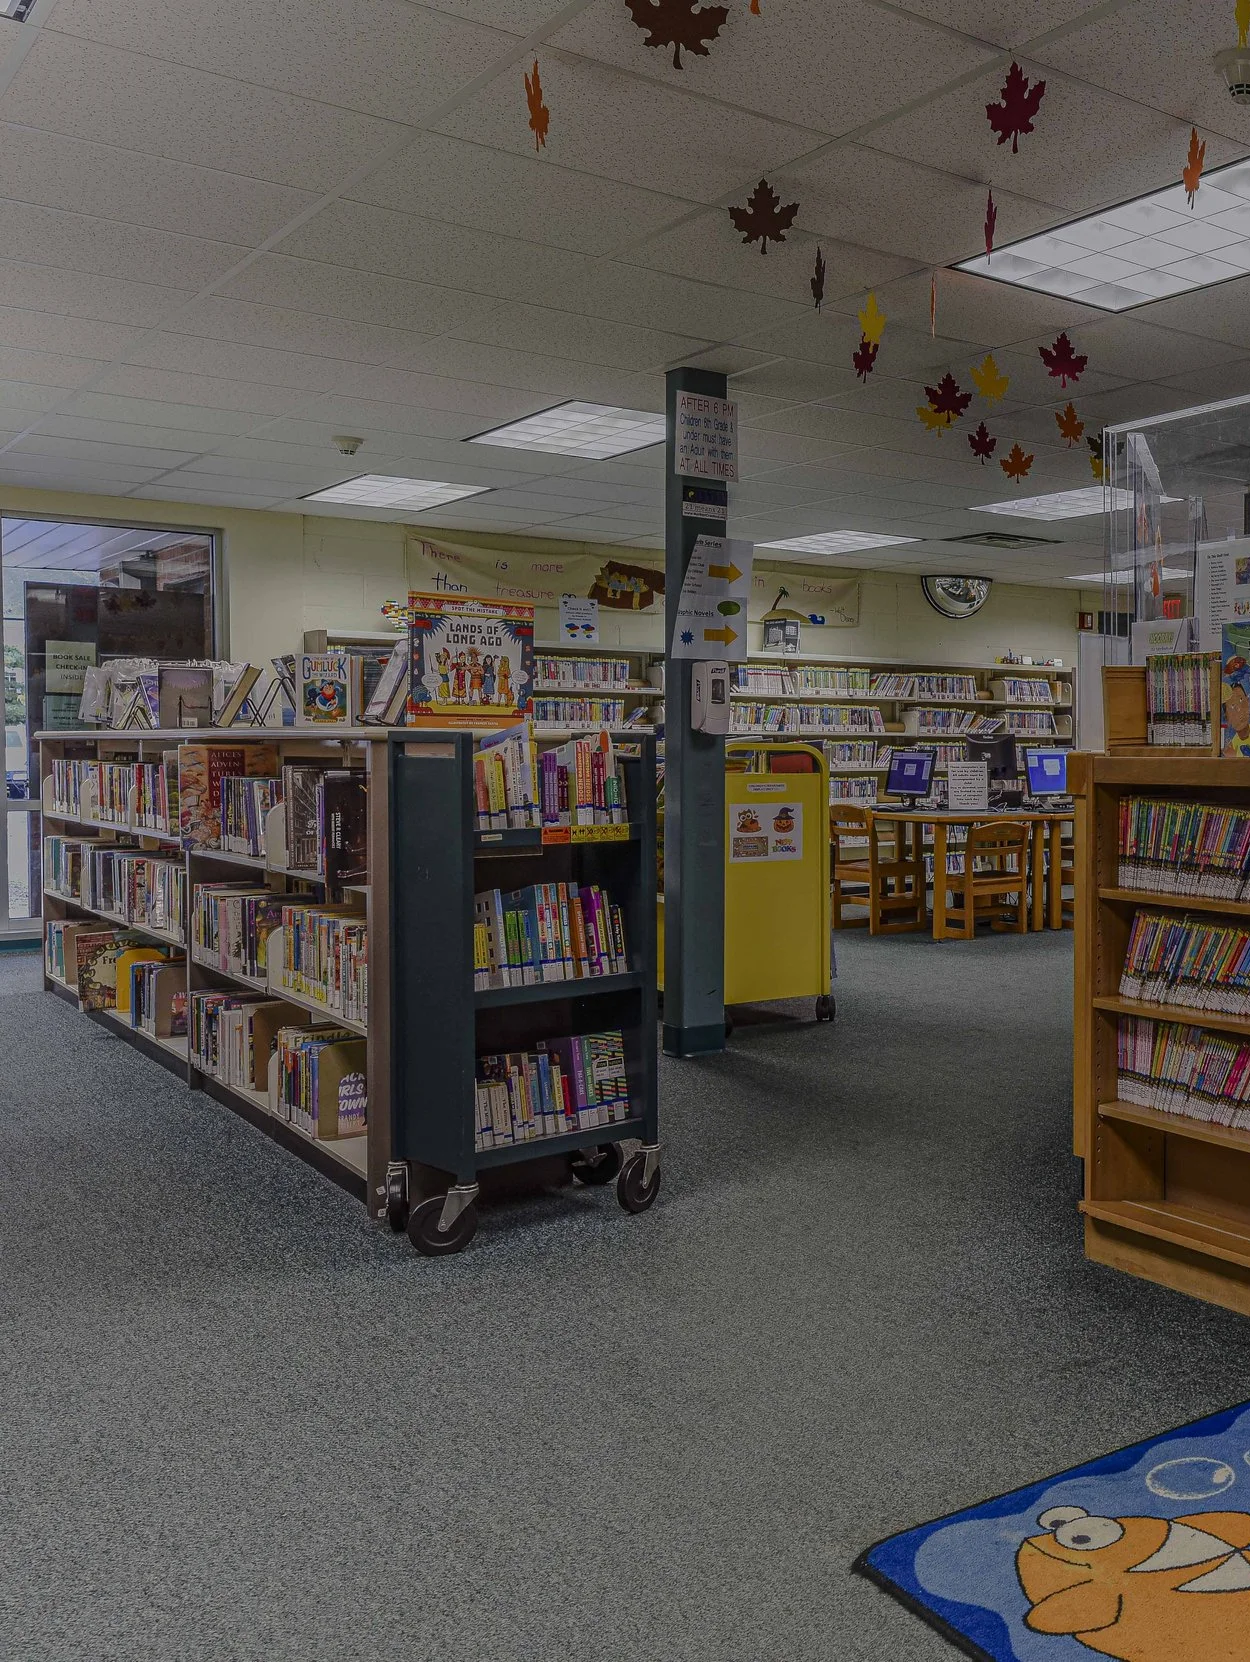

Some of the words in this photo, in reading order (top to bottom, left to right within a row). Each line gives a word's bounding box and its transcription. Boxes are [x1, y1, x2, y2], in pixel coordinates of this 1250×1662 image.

[681, 396, 709, 412] AFTER
[714, 402, 718, 414] 6
[723, 404, 734, 417] PM
[680, 413, 701, 426] Children
[714, 418, 728, 432] Grade
[683, 430, 700, 440] under
[703, 433, 716, 444] must
[719, 434, 732, 446] have
[680, 444, 687, 454] an
[690, 444, 704, 455] Adult
[708, 446, 718, 458] with
[721, 450, 733, 460] them
[680, 458, 690, 470] AT
[694, 460, 708, 473] ALL
[712, 462, 734, 477] TIMES
[704, 540, 722, 548] Series
[410, 537, 462, 563] There
[495, 560, 508, 570] is
[531, 562, 564, 573] more
[432, 572, 468, 593] than
[496, 584, 555, 599] treasure
[755, 576, 764, 587] in
[802, 578, 832, 594] books
[450, 623, 482, 634] LANDS
[487, 626, 499, 635] OF
[447, 634, 476, 645] LONG
[480, 636, 502, 646] AGO
[303, 657, 347, 680] GUMLUCK
[294, 1032, 350, 1047] Frindle
[339, 1097, 368, 1111] OWN
